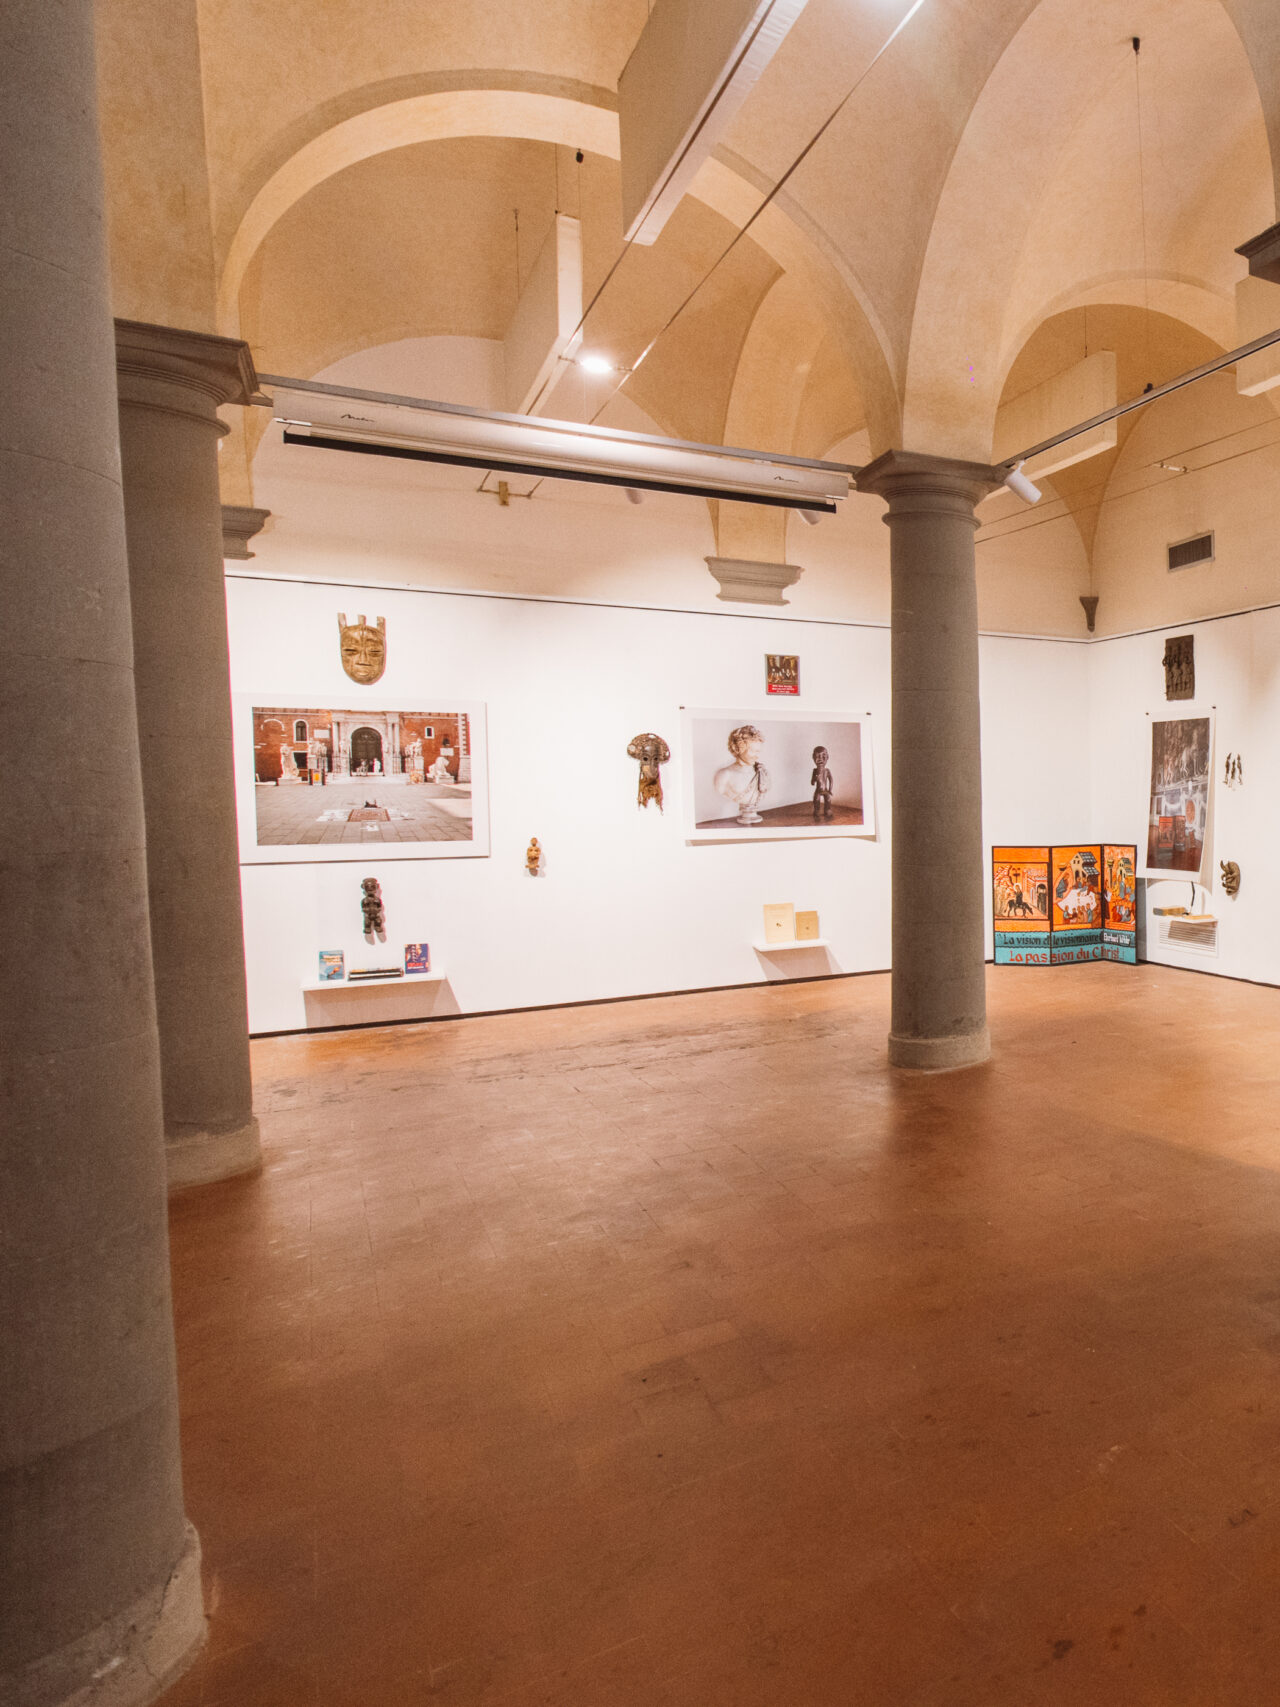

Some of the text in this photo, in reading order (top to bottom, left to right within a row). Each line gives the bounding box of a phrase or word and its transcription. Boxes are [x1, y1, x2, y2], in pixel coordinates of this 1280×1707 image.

[1016, 934, 1041, 945] vision
[1025, 949, 1074, 964] passion
[1076, 947, 1090, 960] du
